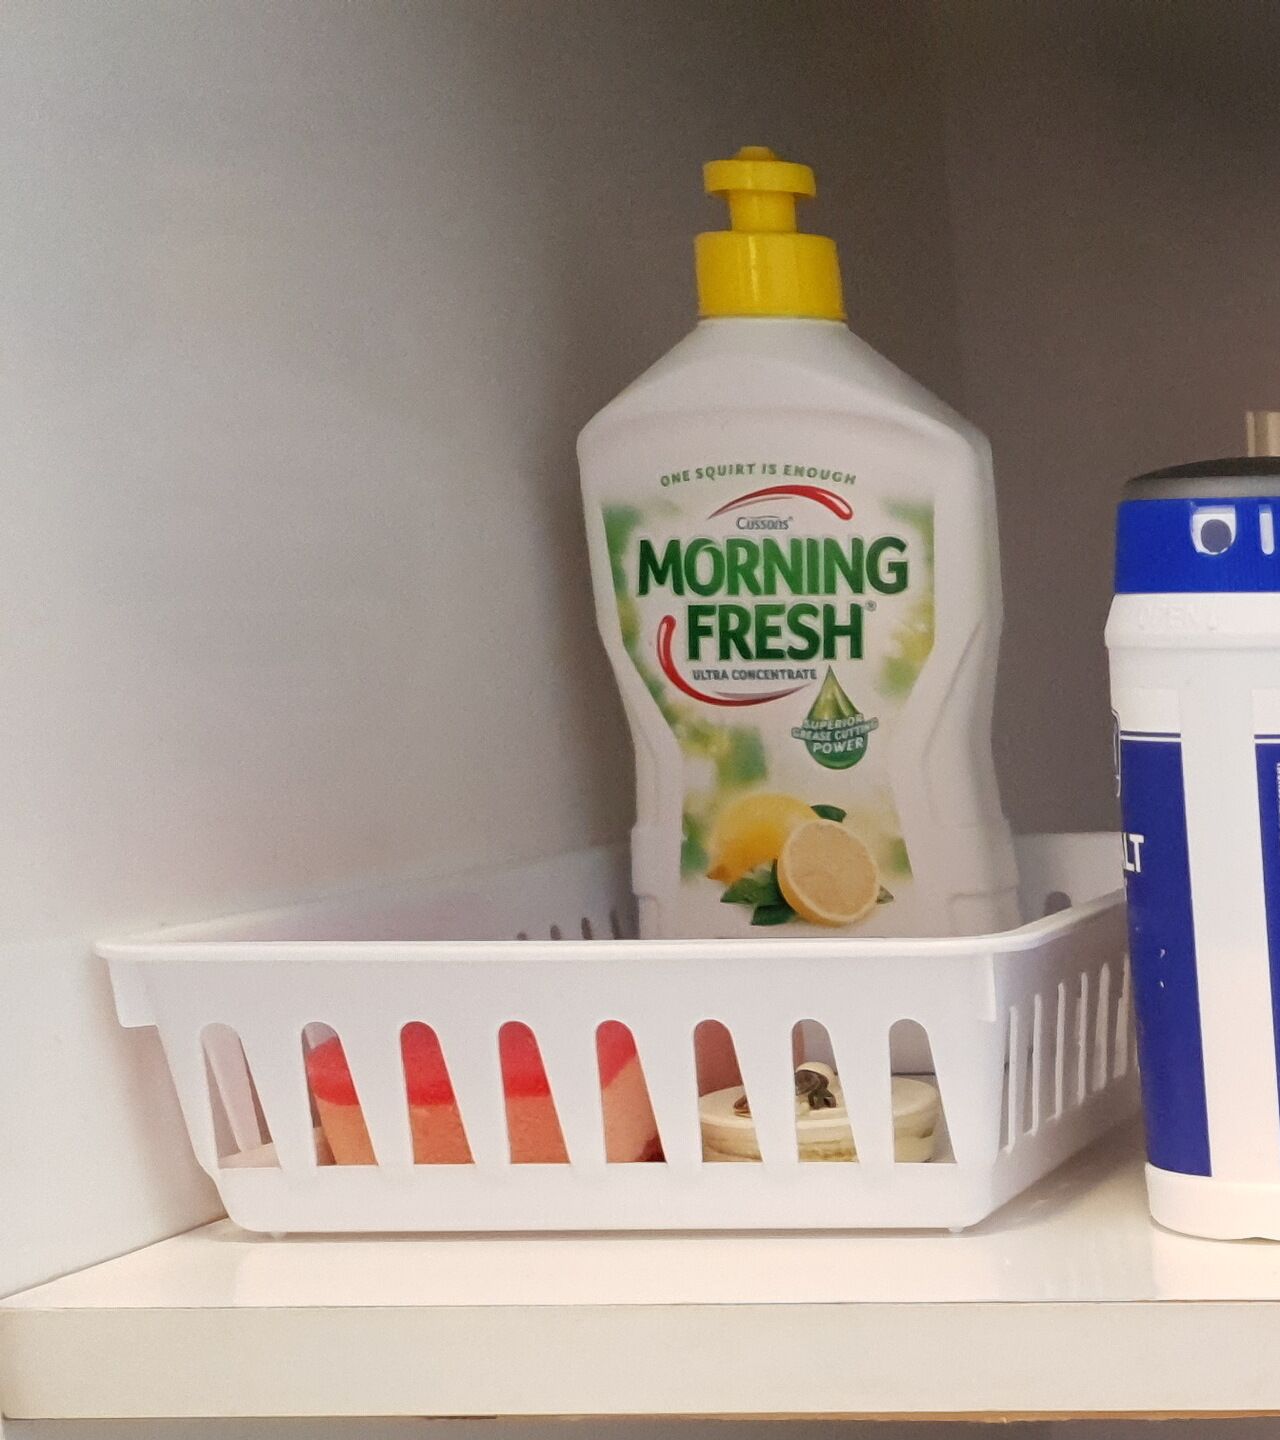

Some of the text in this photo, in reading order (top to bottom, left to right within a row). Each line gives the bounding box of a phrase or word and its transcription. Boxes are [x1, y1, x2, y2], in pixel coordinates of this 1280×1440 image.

[660, 463, 857, 488] ONE SQUIRT IS ENOUGH
[636, 536, 909, 598] MORNING
[686, 602, 864, 662] FRESH
[692, 668, 818, 681] ULTRA CONCENTRATE
[802, 713, 864, 731] SUPERIOR
[812, 736, 865, 755] POWER
